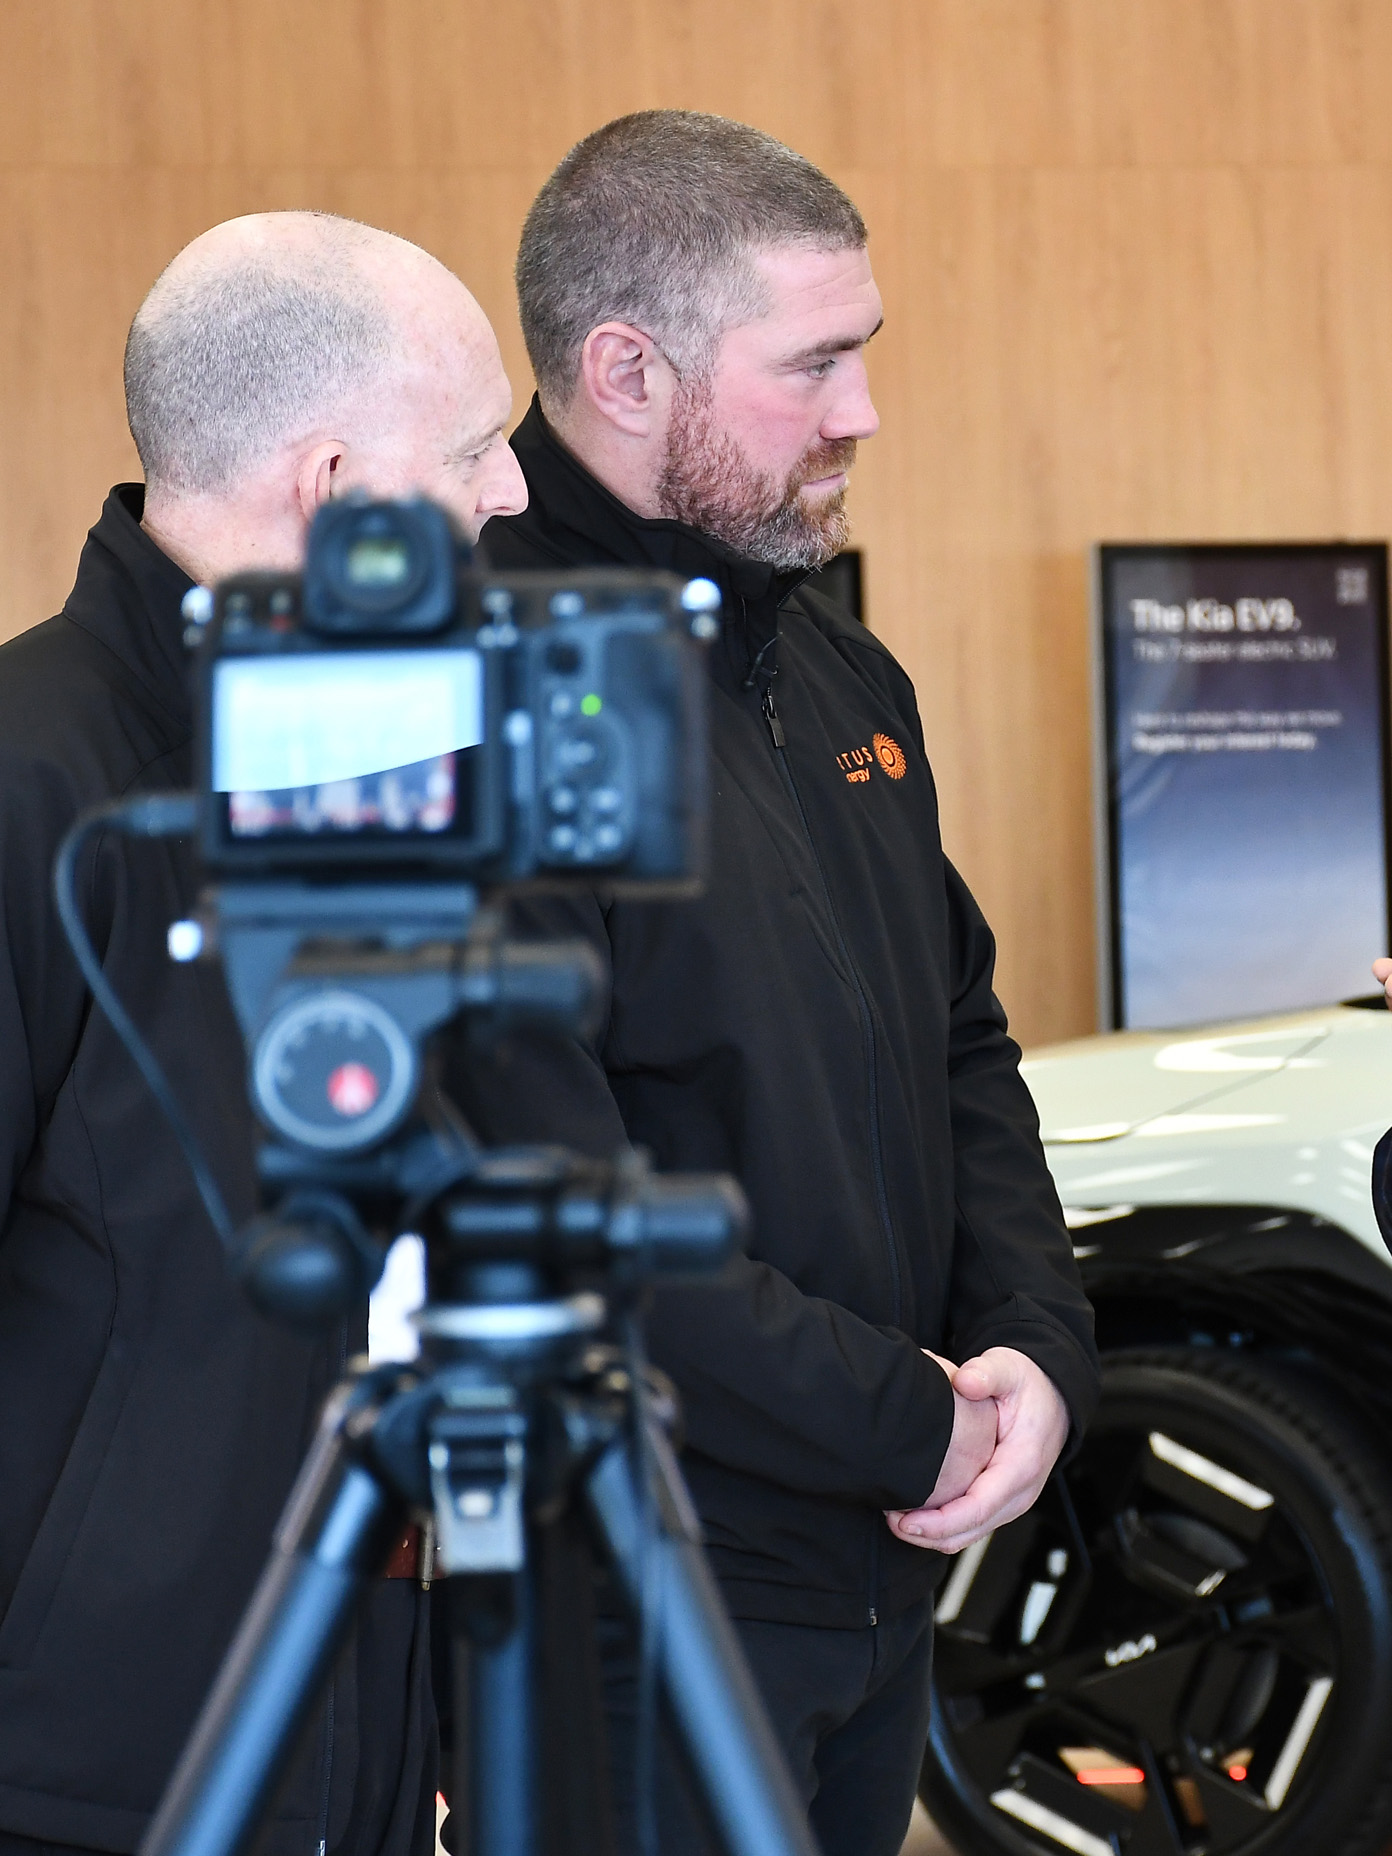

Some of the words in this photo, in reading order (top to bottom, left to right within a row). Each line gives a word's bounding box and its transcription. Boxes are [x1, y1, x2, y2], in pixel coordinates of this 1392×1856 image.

[1131, 599, 1185, 632] The
[1186, 598, 1234, 632] Kia
[845, 767, 871, 783] nergy
